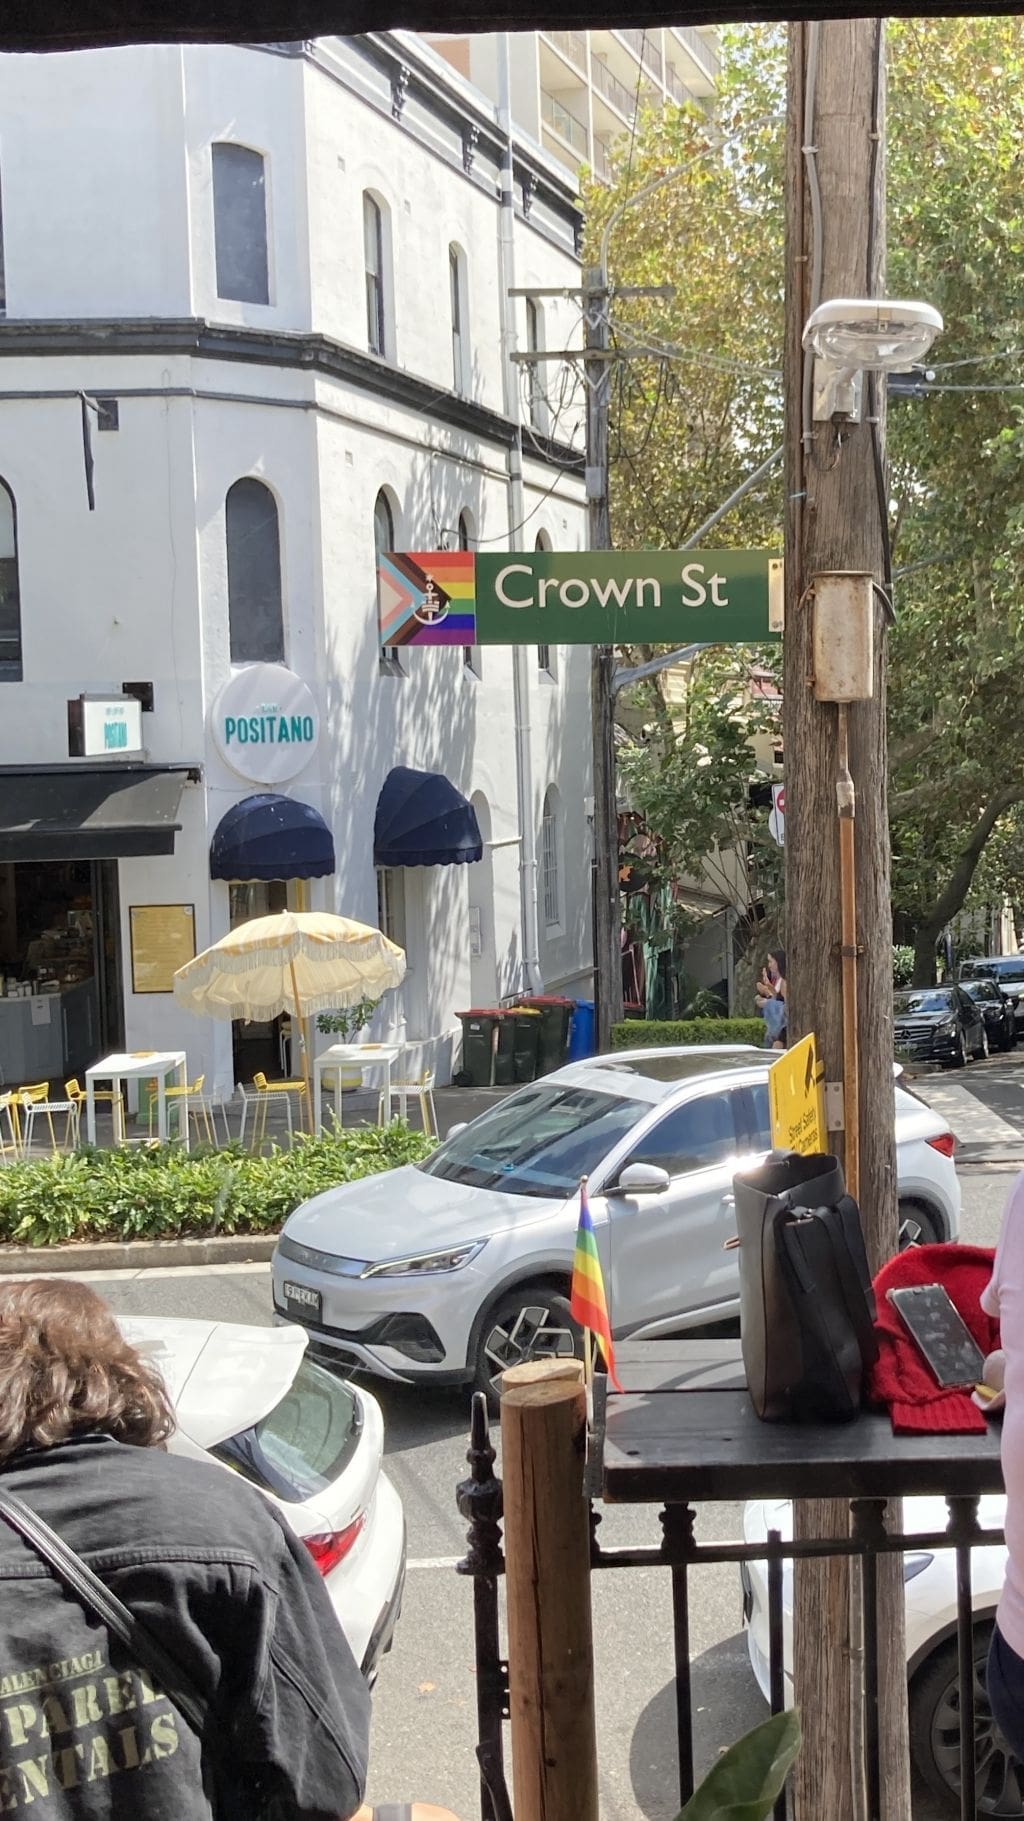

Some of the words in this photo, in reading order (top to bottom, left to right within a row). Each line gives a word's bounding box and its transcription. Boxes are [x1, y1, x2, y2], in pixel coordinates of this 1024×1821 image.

[495, 564, 661, 608] Crown
[681, 563, 729, 607] St
[225, 715, 313, 744] POSITANO
